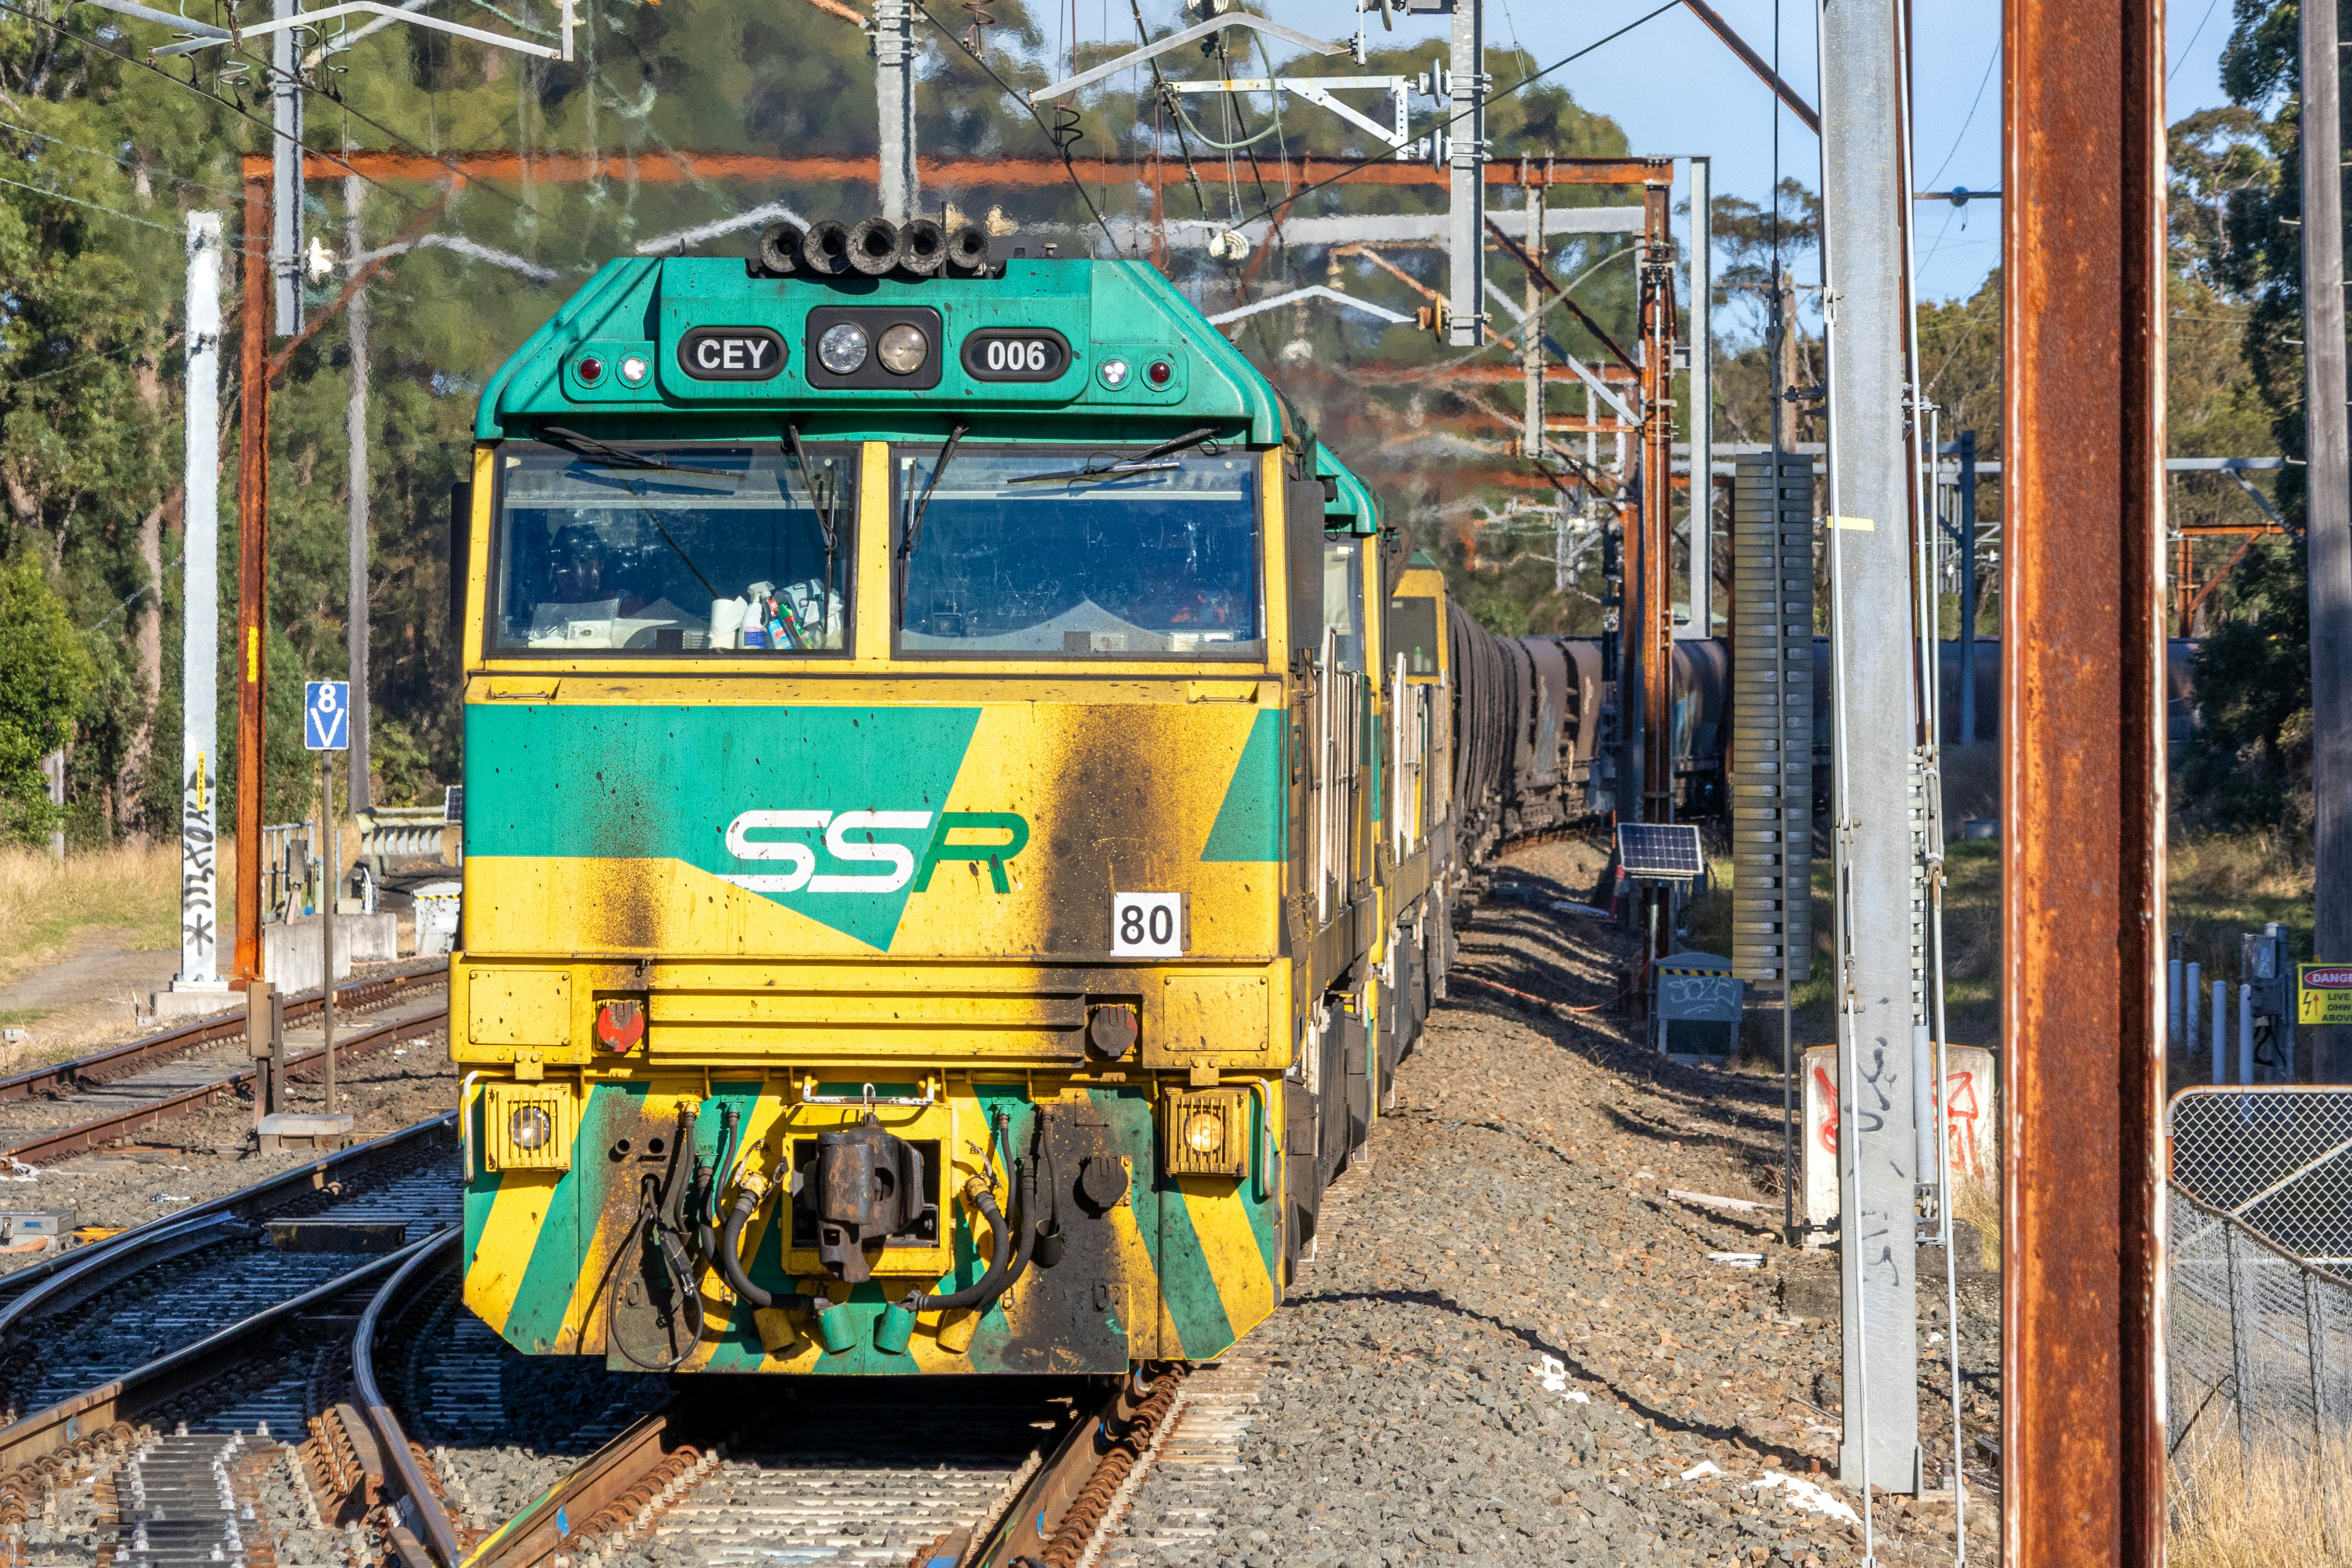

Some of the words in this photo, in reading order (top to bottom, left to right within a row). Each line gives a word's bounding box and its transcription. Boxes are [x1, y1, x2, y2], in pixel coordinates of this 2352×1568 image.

[697, 339, 769, 369] CEY
[987, 340, 1045, 371] 006
[318, 684, 336, 713] 8
[714, 809, 1030, 895] SSR
[1120, 905, 1173, 945] 80
